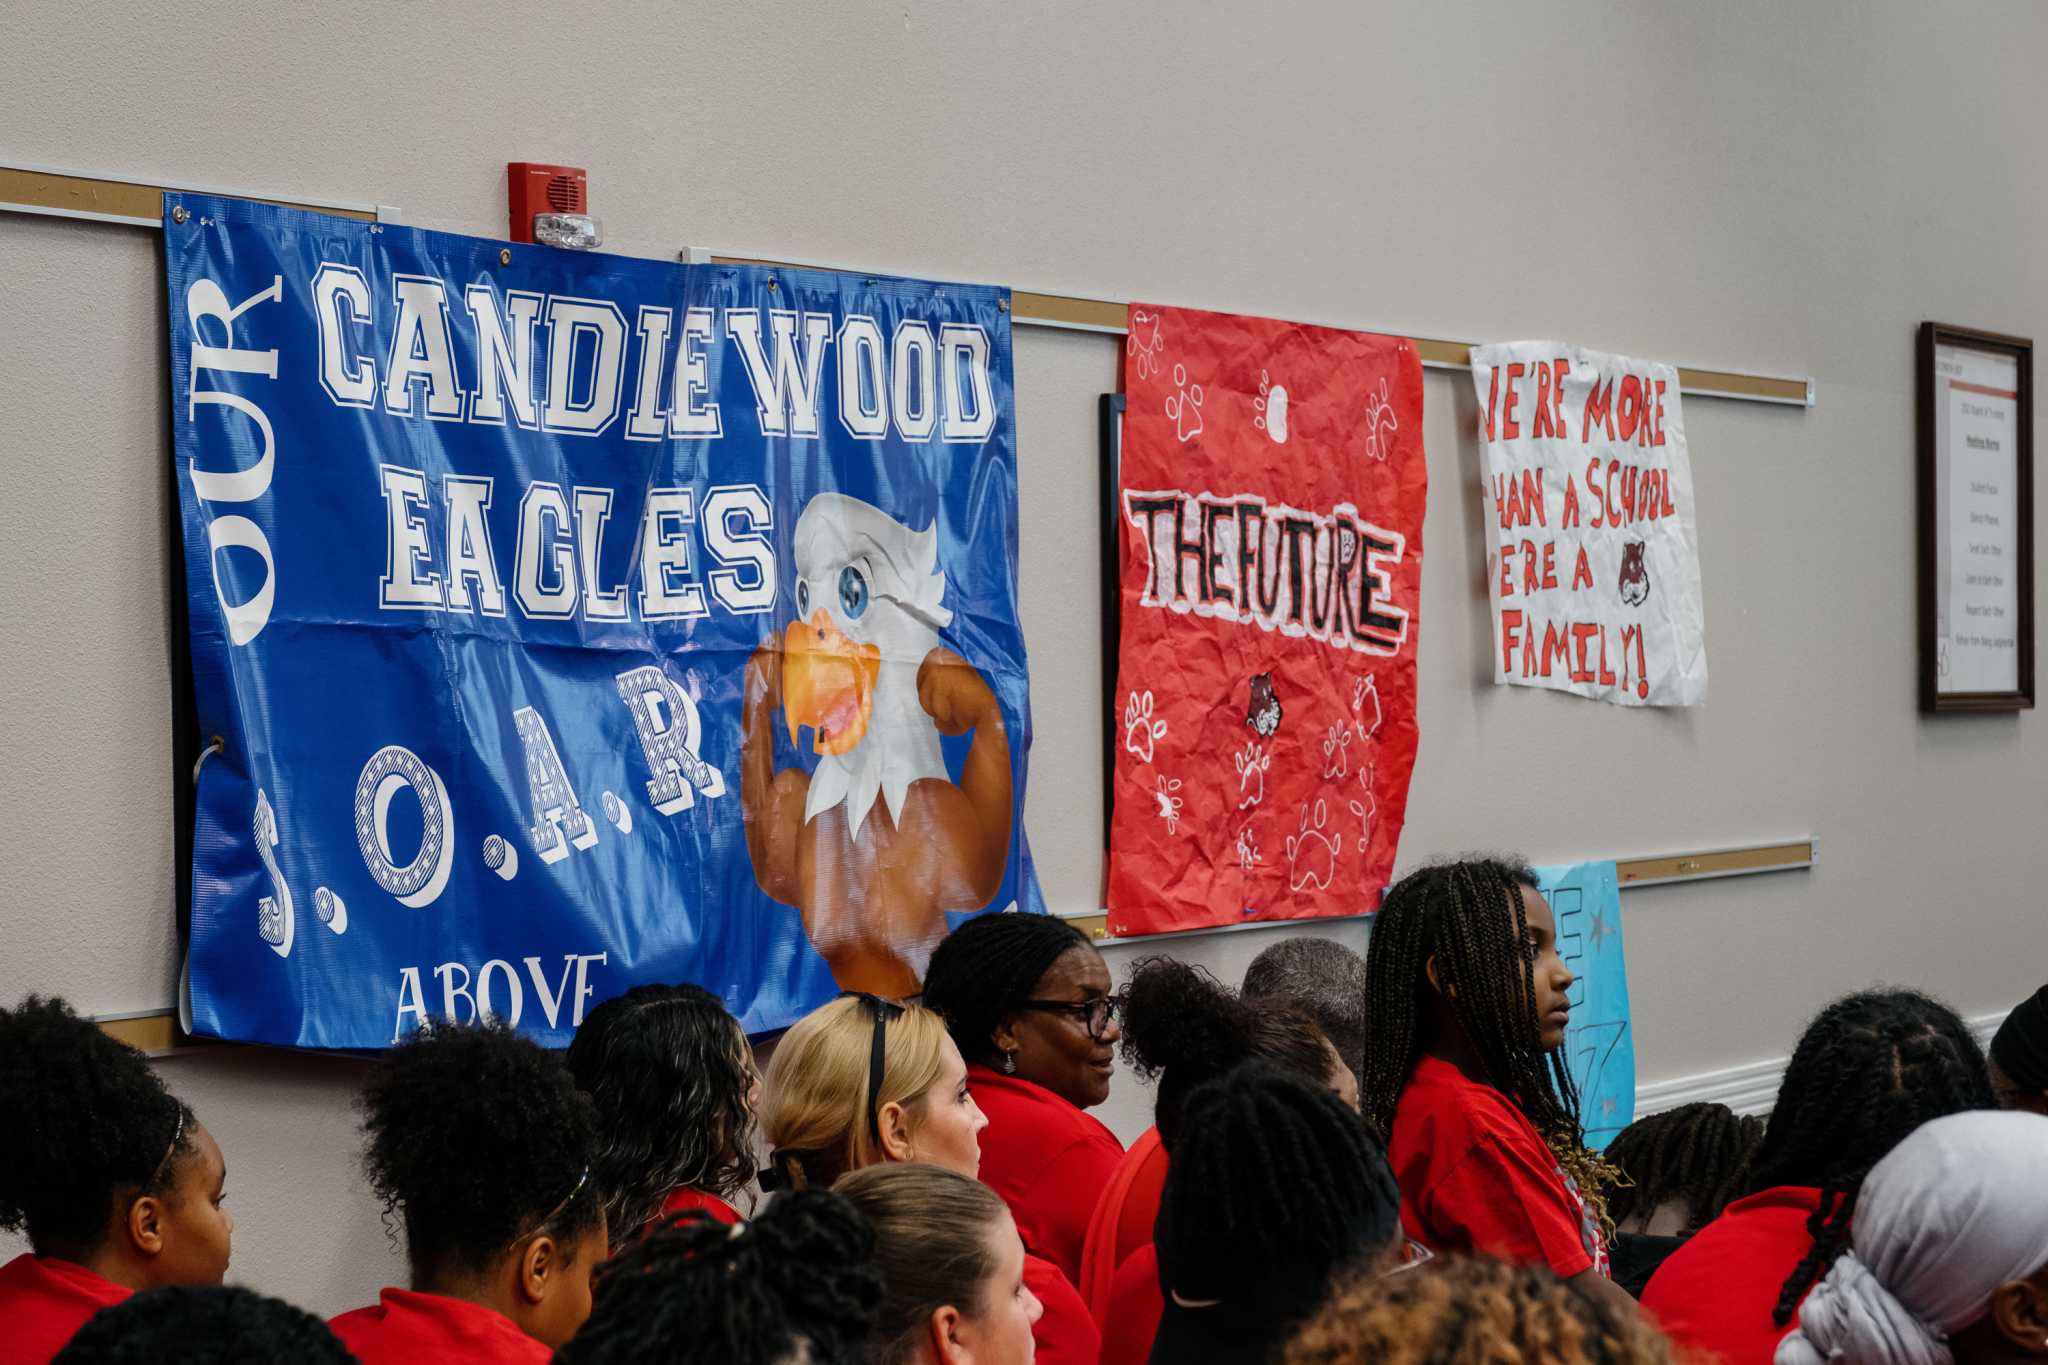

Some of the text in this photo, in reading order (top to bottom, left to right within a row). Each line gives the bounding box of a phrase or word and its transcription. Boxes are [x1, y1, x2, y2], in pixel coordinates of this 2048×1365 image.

[1582, 374, 1667, 448] MORE
[187, 274, 284, 647] OUR
[1492, 457, 1676, 530] HAN A SCHOOL
[378, 463, 779, 624] EAGLES
[1571, 540, 1594, 591] A
[1501, 608, 1650, 699] FAMILY!
